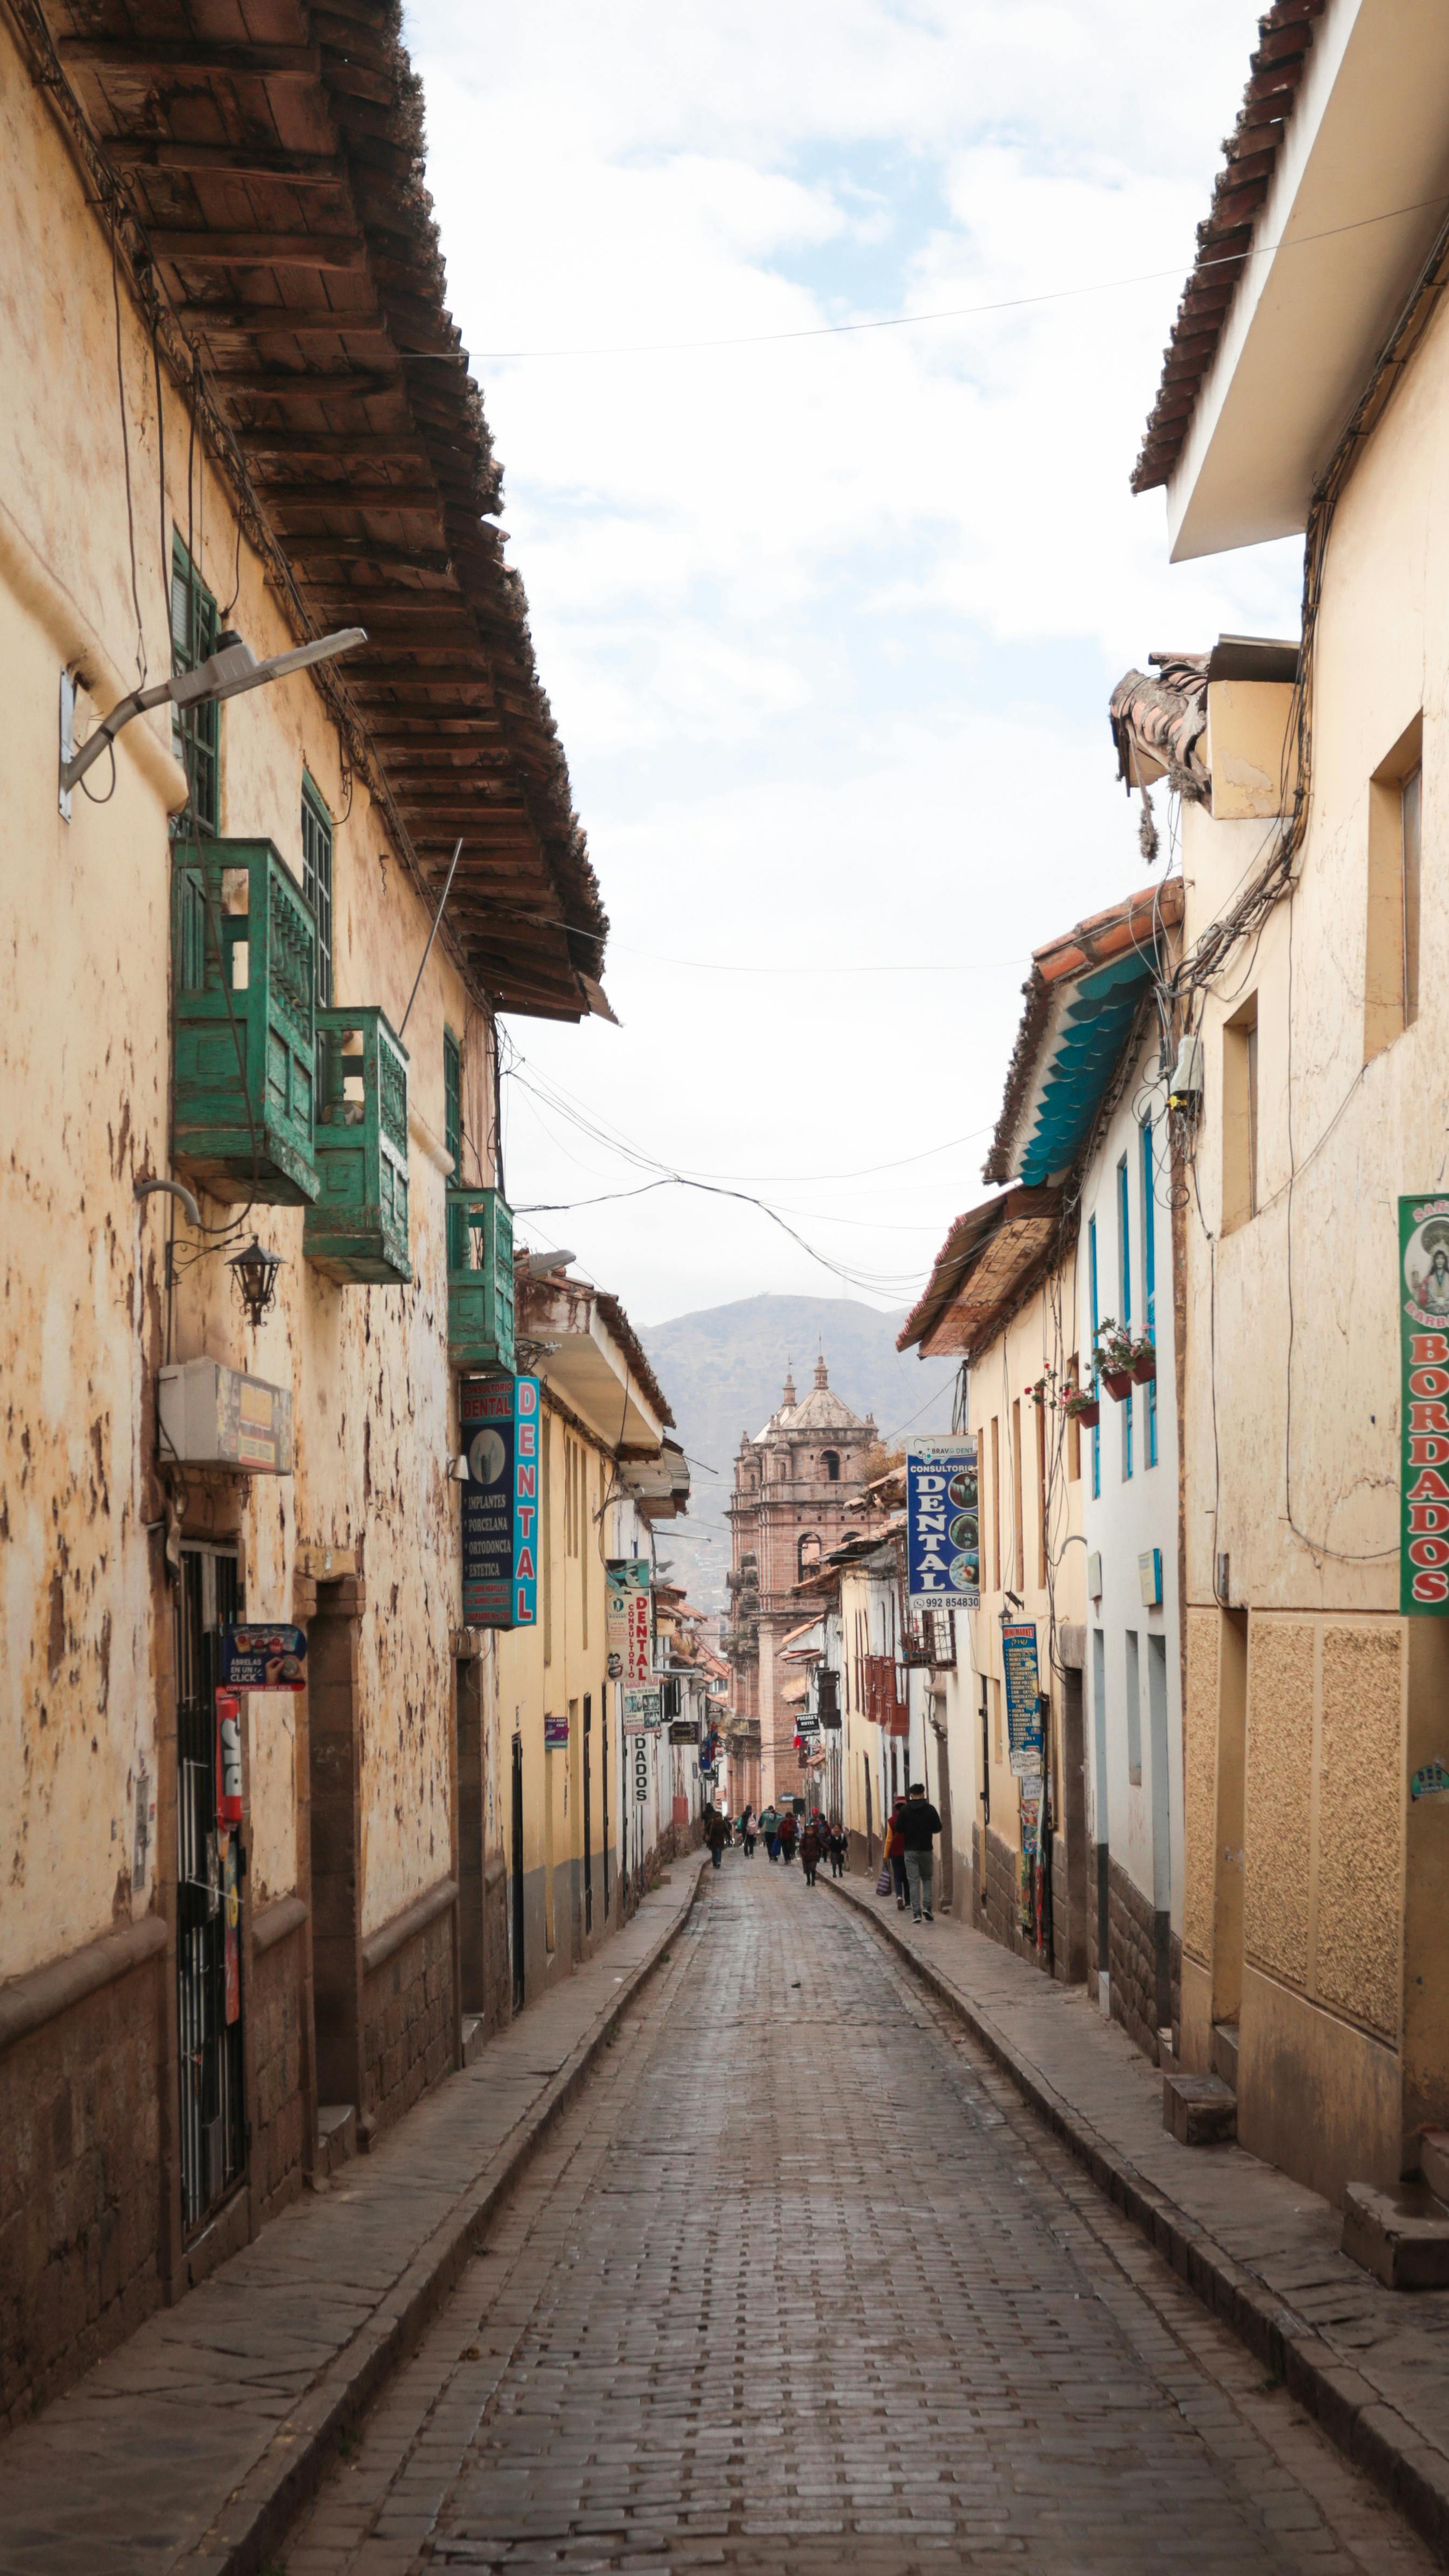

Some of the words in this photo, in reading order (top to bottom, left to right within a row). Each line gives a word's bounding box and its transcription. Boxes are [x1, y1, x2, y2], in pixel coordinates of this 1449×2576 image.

[1413, 1200, 1449, 1223] SAN
[1405, 1300, 1449, 1329] BARB
[464, 1382, 512, 1395] CONSULTORIO
[464, 1395, 512, 1419] DENTAL
[1407, 1333, 1449, 1603] BORDADOS
[468, 1495, 506, 1510] IMPLANTES
[516, 1382, 536, 1621] DENTAL
[469, 1517, 508, 1532] PORCELANA
[916, 1475, 949, 1590] DENTAL
[469, 1540, 511, 1555] ORTODONCIA
[469, 1563, 500, 1577] ESTETICA
[926, 1598, 943, 1608] 992
[946, 1597, 979, 1607] 854830
[636, 1597, 648, 1681] DENTAL
[1003, 1627, 1014, 1639] MINI
[1015, 1626, 1034, 1639] MARKET
[230, 1674, 257, 1682] CLICK
[635, 1733, 647, 1801] DADOS
